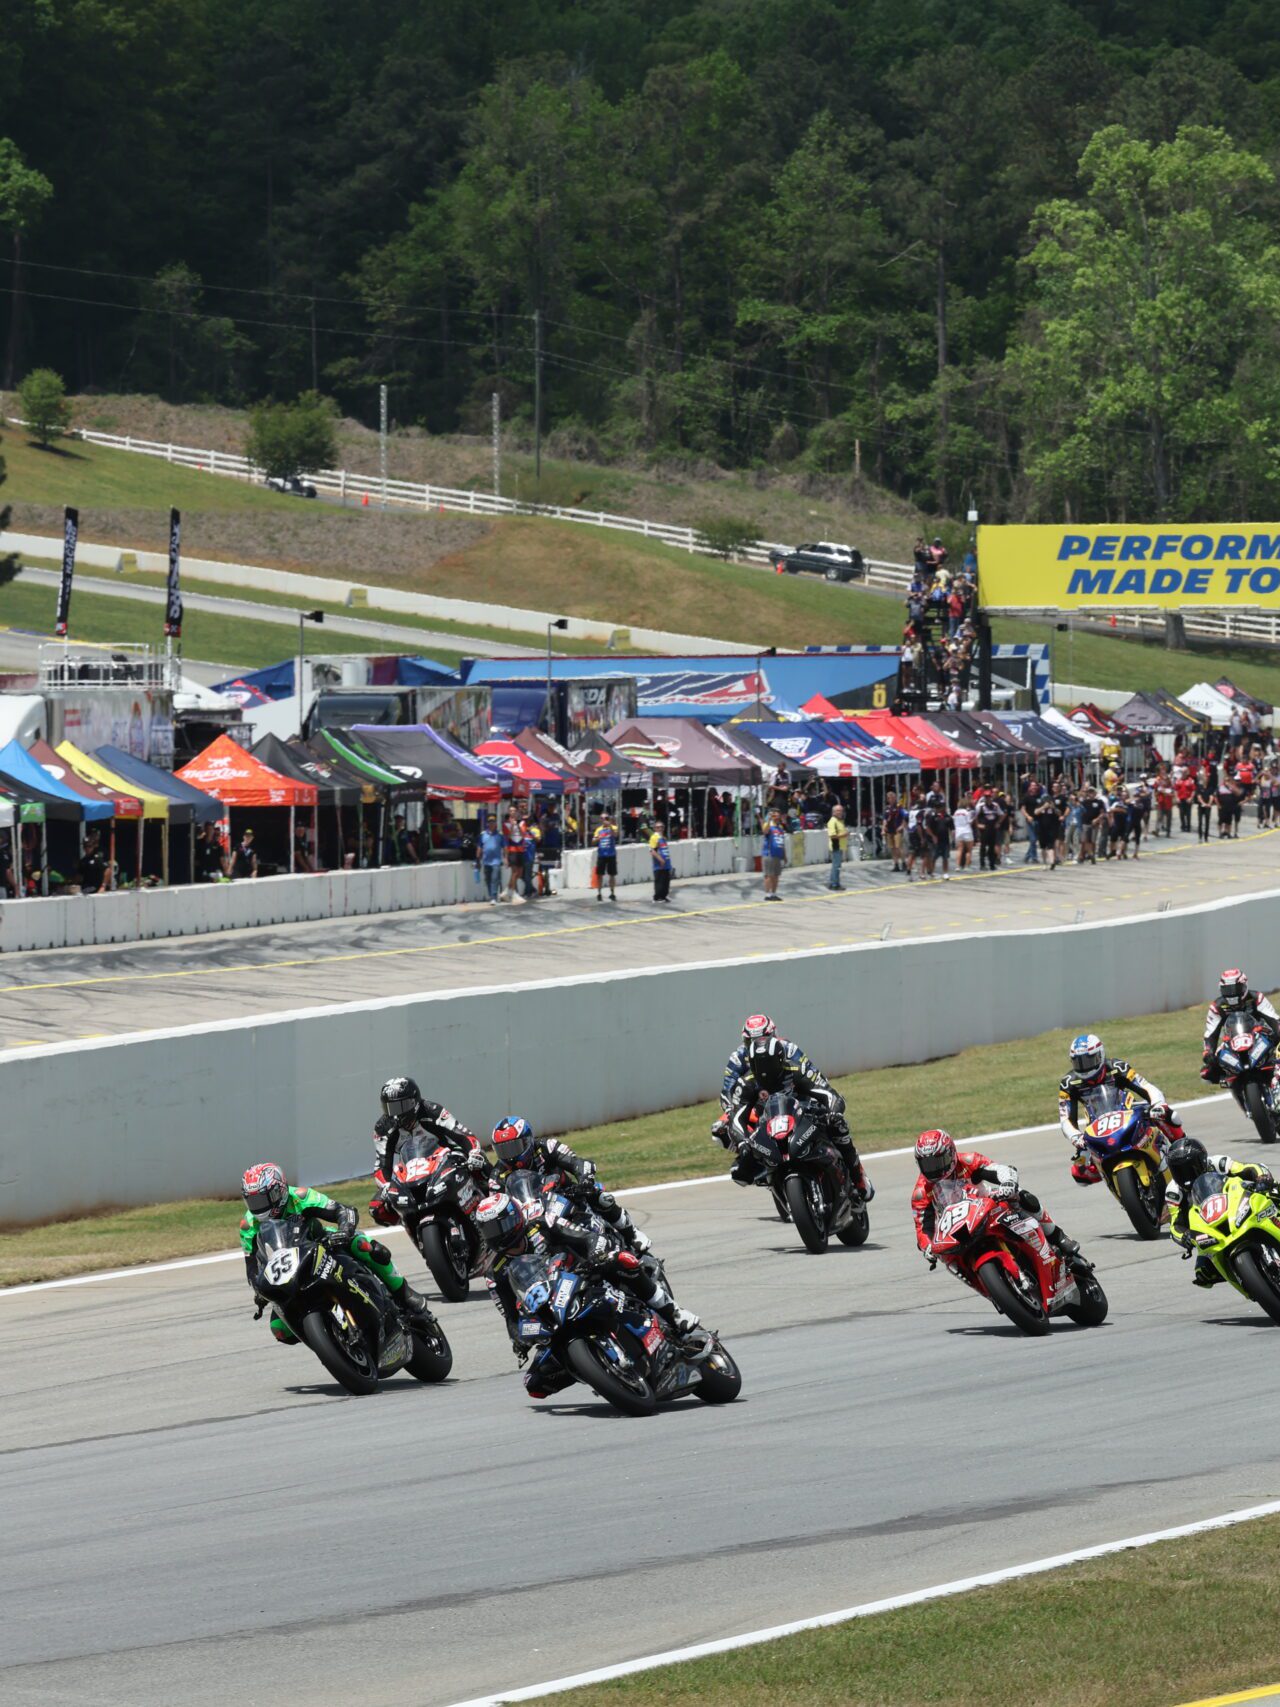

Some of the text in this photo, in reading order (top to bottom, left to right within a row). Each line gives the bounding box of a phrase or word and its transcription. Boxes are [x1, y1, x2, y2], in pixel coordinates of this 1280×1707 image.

[1066, 568, 1217, 595] MADE
[1097, 1114, 1121, 1136] 96
[270, 1253, 293, 1282] 55
[320, 1255, 333, 1280] WORLD
